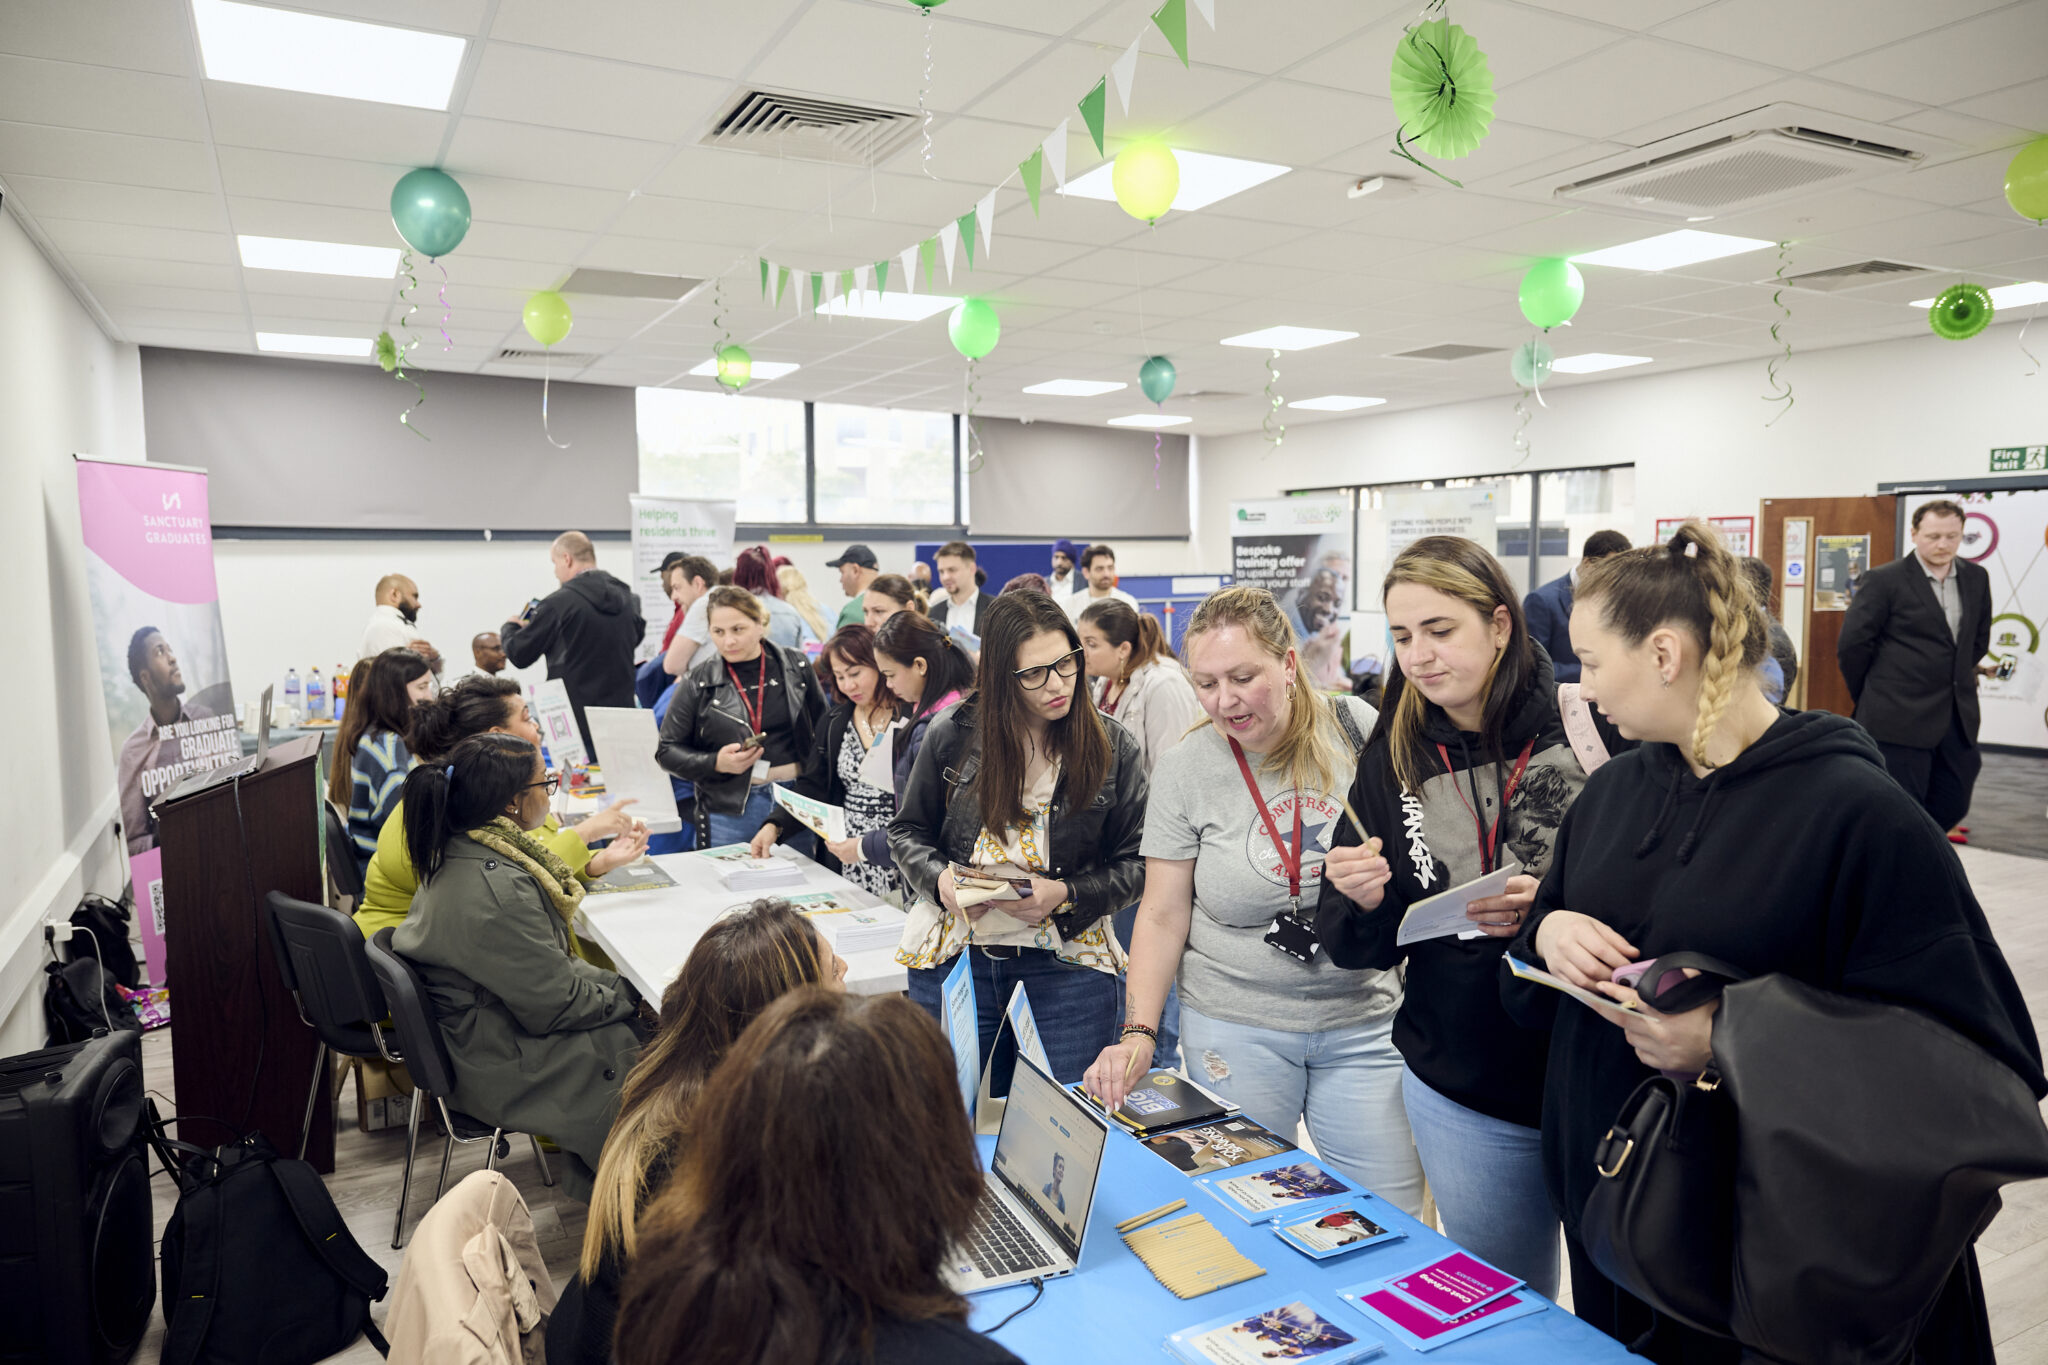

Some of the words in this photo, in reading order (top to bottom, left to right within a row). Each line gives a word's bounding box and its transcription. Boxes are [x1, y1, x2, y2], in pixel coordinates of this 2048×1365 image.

[1994, 450, 2020, 460] Fire
[1993, 460, 2018, 470] exit
[143, 515, 203, 529] SANCTUARY
[640, 509, 678, 523] Helping
[145, 532, 207, 545] GRADUATES
[640, 526, 687, 536] residents
[689, 526, 716, 537] thrive
[1236, 545, 1282, 557] Bespoke
[1236, 557, 1278, 570] training
[1279, 555, 1306, 567] offer
[1236, 569, 1246, 578] to
[1247, 568, 1275, 580] upskill
[1275, 568, 1296, 577] and
[1267, 580, 1288, 589] your
[1289, 577, 1312, 588] staff
[159, 724, 175, 740] ARE
[174, 722, 189, 738] YOU
[189, 716, 220, 735] LOOKING
[221, 714, 235, 729] FOR
[180, 729, 238, 759] GRADUATE
[1127, 1092, 1165, 1112] BIG
[1199, 1127, 1244, 1152] BANKING
[1210, 1144, 1241, 1161] YOUR
[1419, 1274, 1442, 1288] living
[1450, 1290, 1472, 1303] Cost
